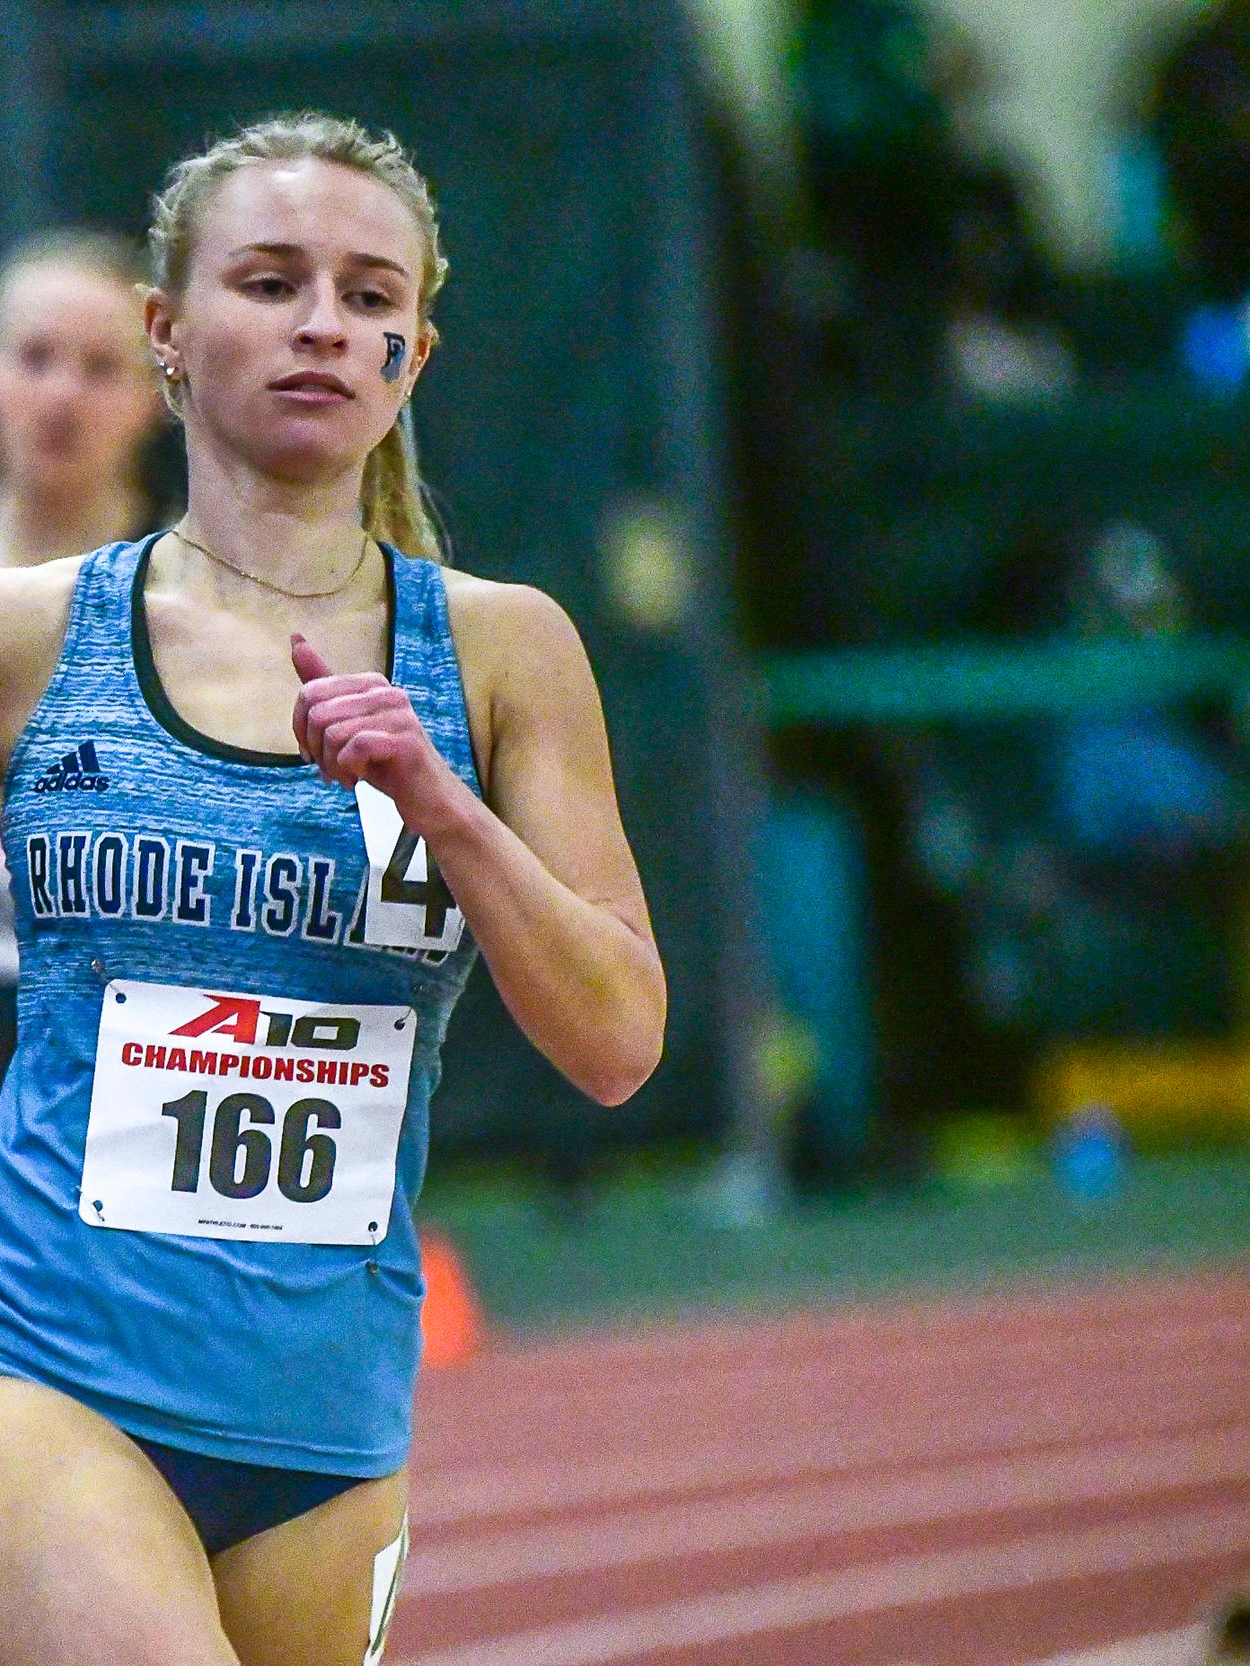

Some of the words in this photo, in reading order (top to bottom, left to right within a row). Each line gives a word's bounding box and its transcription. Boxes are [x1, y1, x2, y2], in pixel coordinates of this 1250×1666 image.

[34, 770, 110, 793] adidas
[26, 831, 216, 926] RHODE
[230, 848, 450, 967] ISL
[380, 821, 457, 938] 4
[121, 1042, 390, 1087] CHAMPIONSHIPS
[162, 1090, 342, 1203] 166
